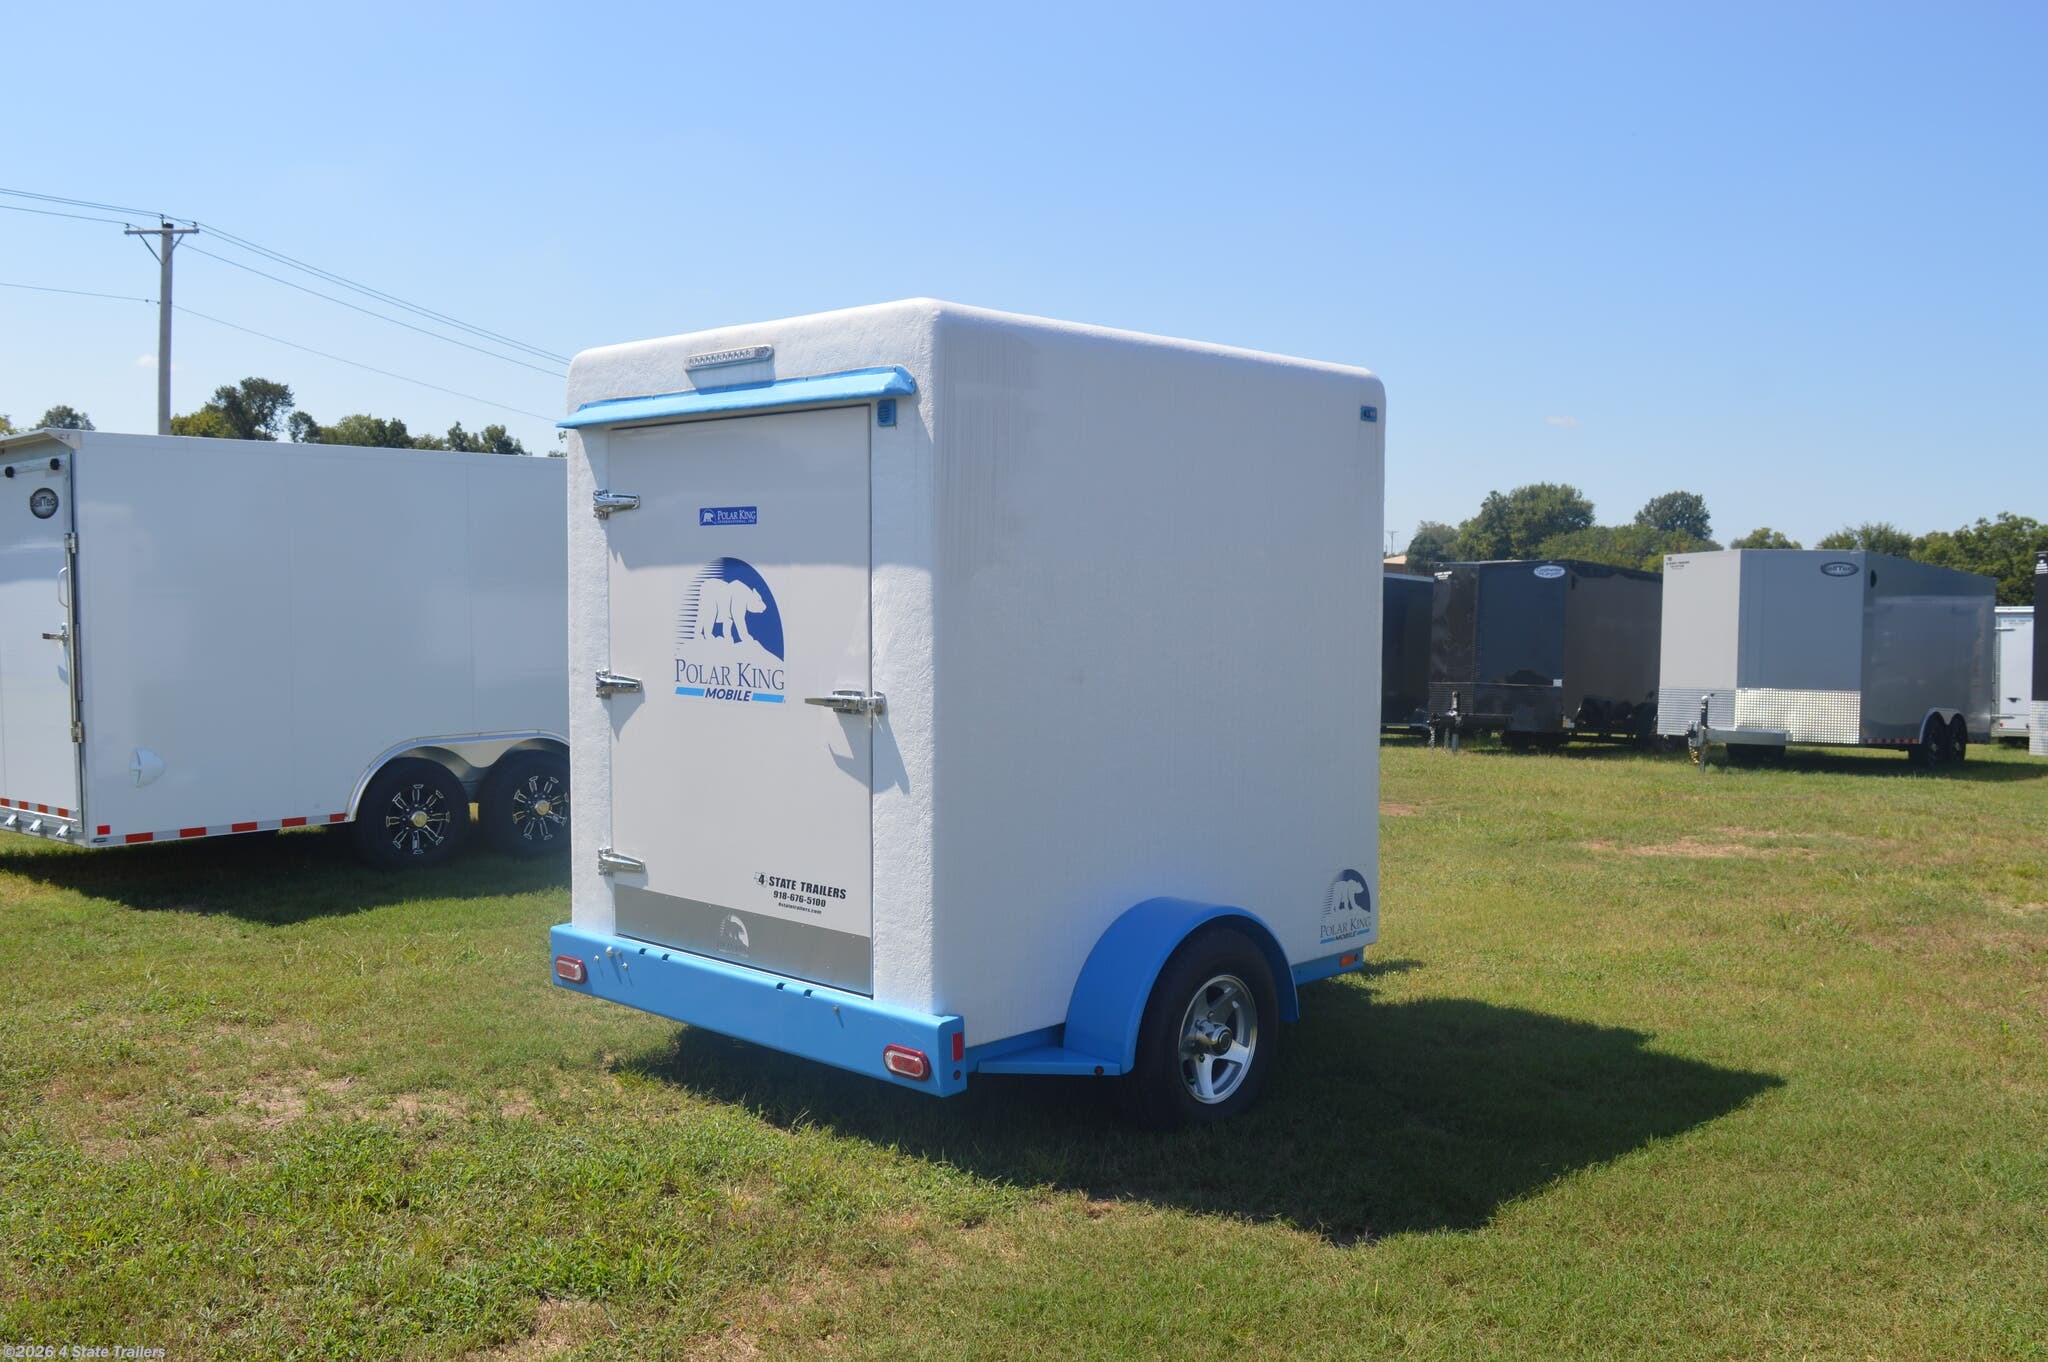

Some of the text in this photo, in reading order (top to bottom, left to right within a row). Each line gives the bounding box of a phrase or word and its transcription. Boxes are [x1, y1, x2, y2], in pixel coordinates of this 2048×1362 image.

[717, 509, 757, 520] POLAR KING
[675, 658, 785, 690] POLAR KING
[704, 687, 752, 702] MOBILE
[758, 874, 847, 900] 4 STATE TRAILERS
[773, 890, 827, 908] 918-676-5100
[1320, 916, 1372, 938] POLAR KING
